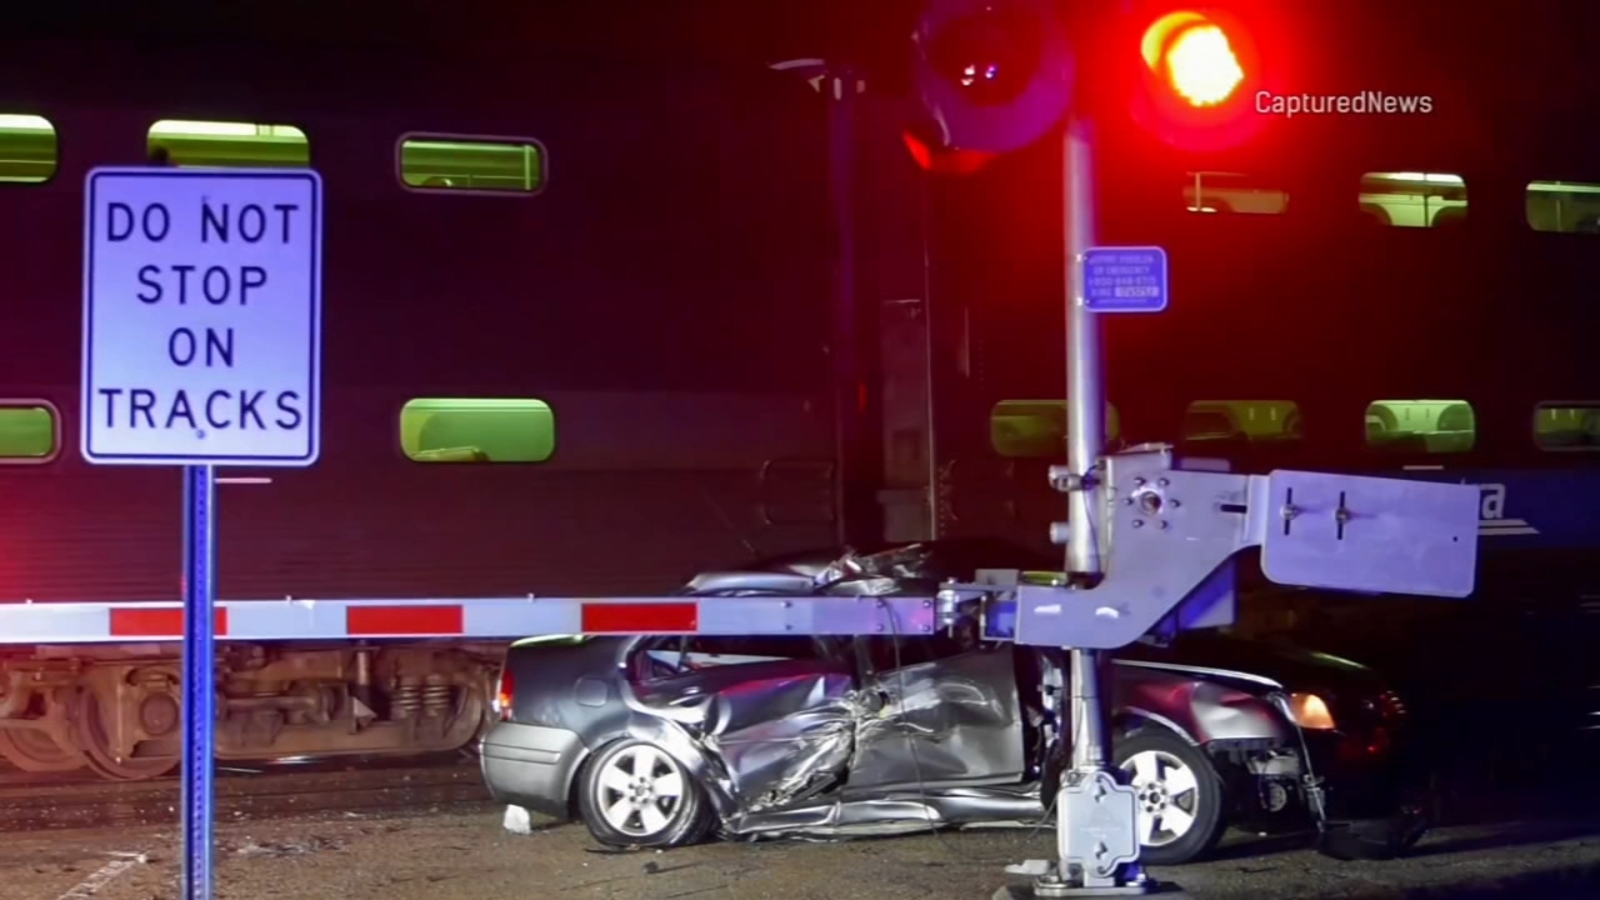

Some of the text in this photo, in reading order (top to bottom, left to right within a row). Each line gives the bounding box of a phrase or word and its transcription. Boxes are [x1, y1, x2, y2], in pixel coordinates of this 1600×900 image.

[107, 201, 299, 244] DO NOT
[137, 264, 267, 305] STOP
[168, 327, 233, 367] ON
[99, 388, 302, 429] TRACKS
